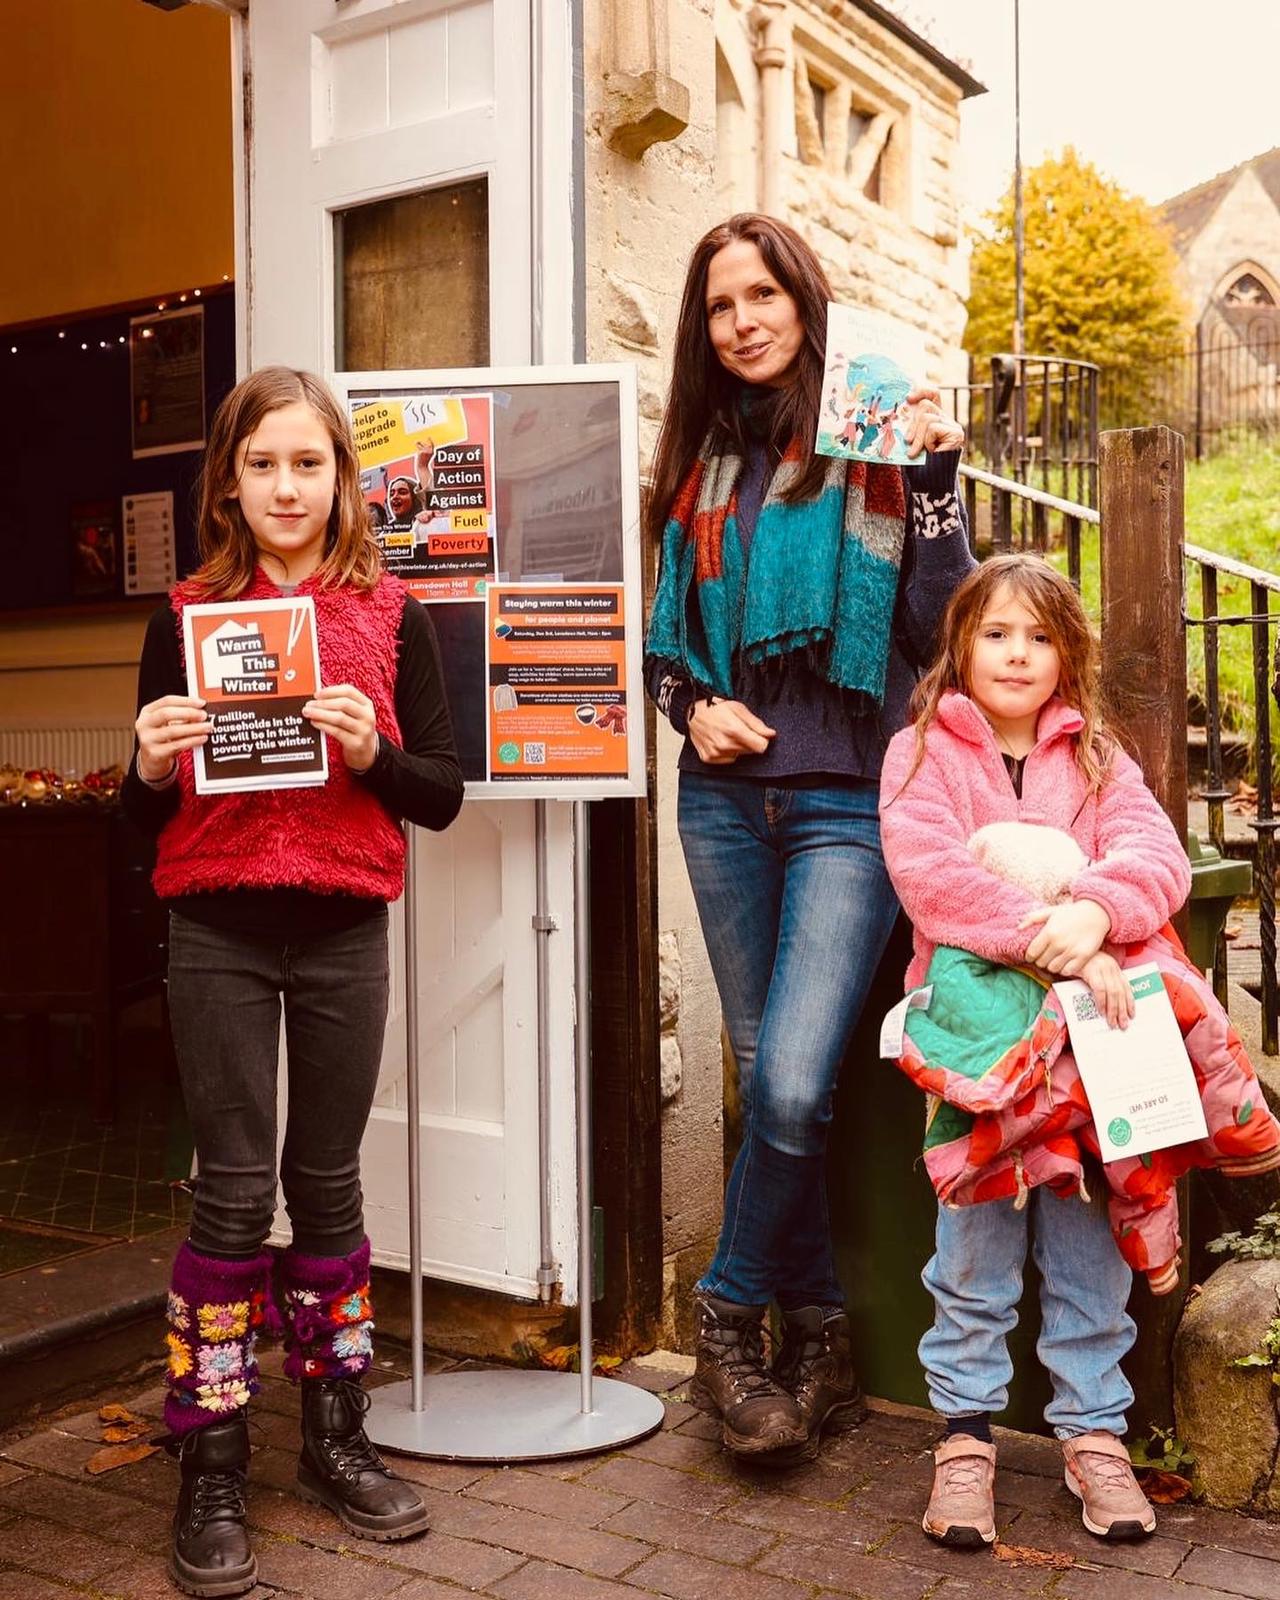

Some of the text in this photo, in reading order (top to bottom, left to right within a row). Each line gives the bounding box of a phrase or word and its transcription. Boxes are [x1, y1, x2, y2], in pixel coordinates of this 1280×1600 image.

[377, 409, 388, 418] to
[353, 419, 396, 440] upgrade
[437, 448, 480, 464] Day of
[437, 471, 481, 485] Action
[429, 492, 483, 509] Against
[454, 515, 483, 528] Fuel
[431, 537, 484, 552] Poverty
[409, 580, 468, 590] Lansdown Hall
[505, 600, 538, 609] Staying
[565, 599, 582, 607] this
[583, 599, 612, 607] winter
[538, 616, 566, 625] people
[585, 615, 611, 625] planet
[218, 639, 262, 654] Warm
[244, 657, 276, 670] This
[224, 680, 274, 693] Winter
[218, 711, 256, 723] million
[210, 715, 303, 733] households in the
[211, 726, 300, 744] UK will be in fuel
[212, 736, 315, 757] poverty this winter.
[1143, 1098, 1158, 1110] ARE
[1157, 1094, 1168, 1105] SO
